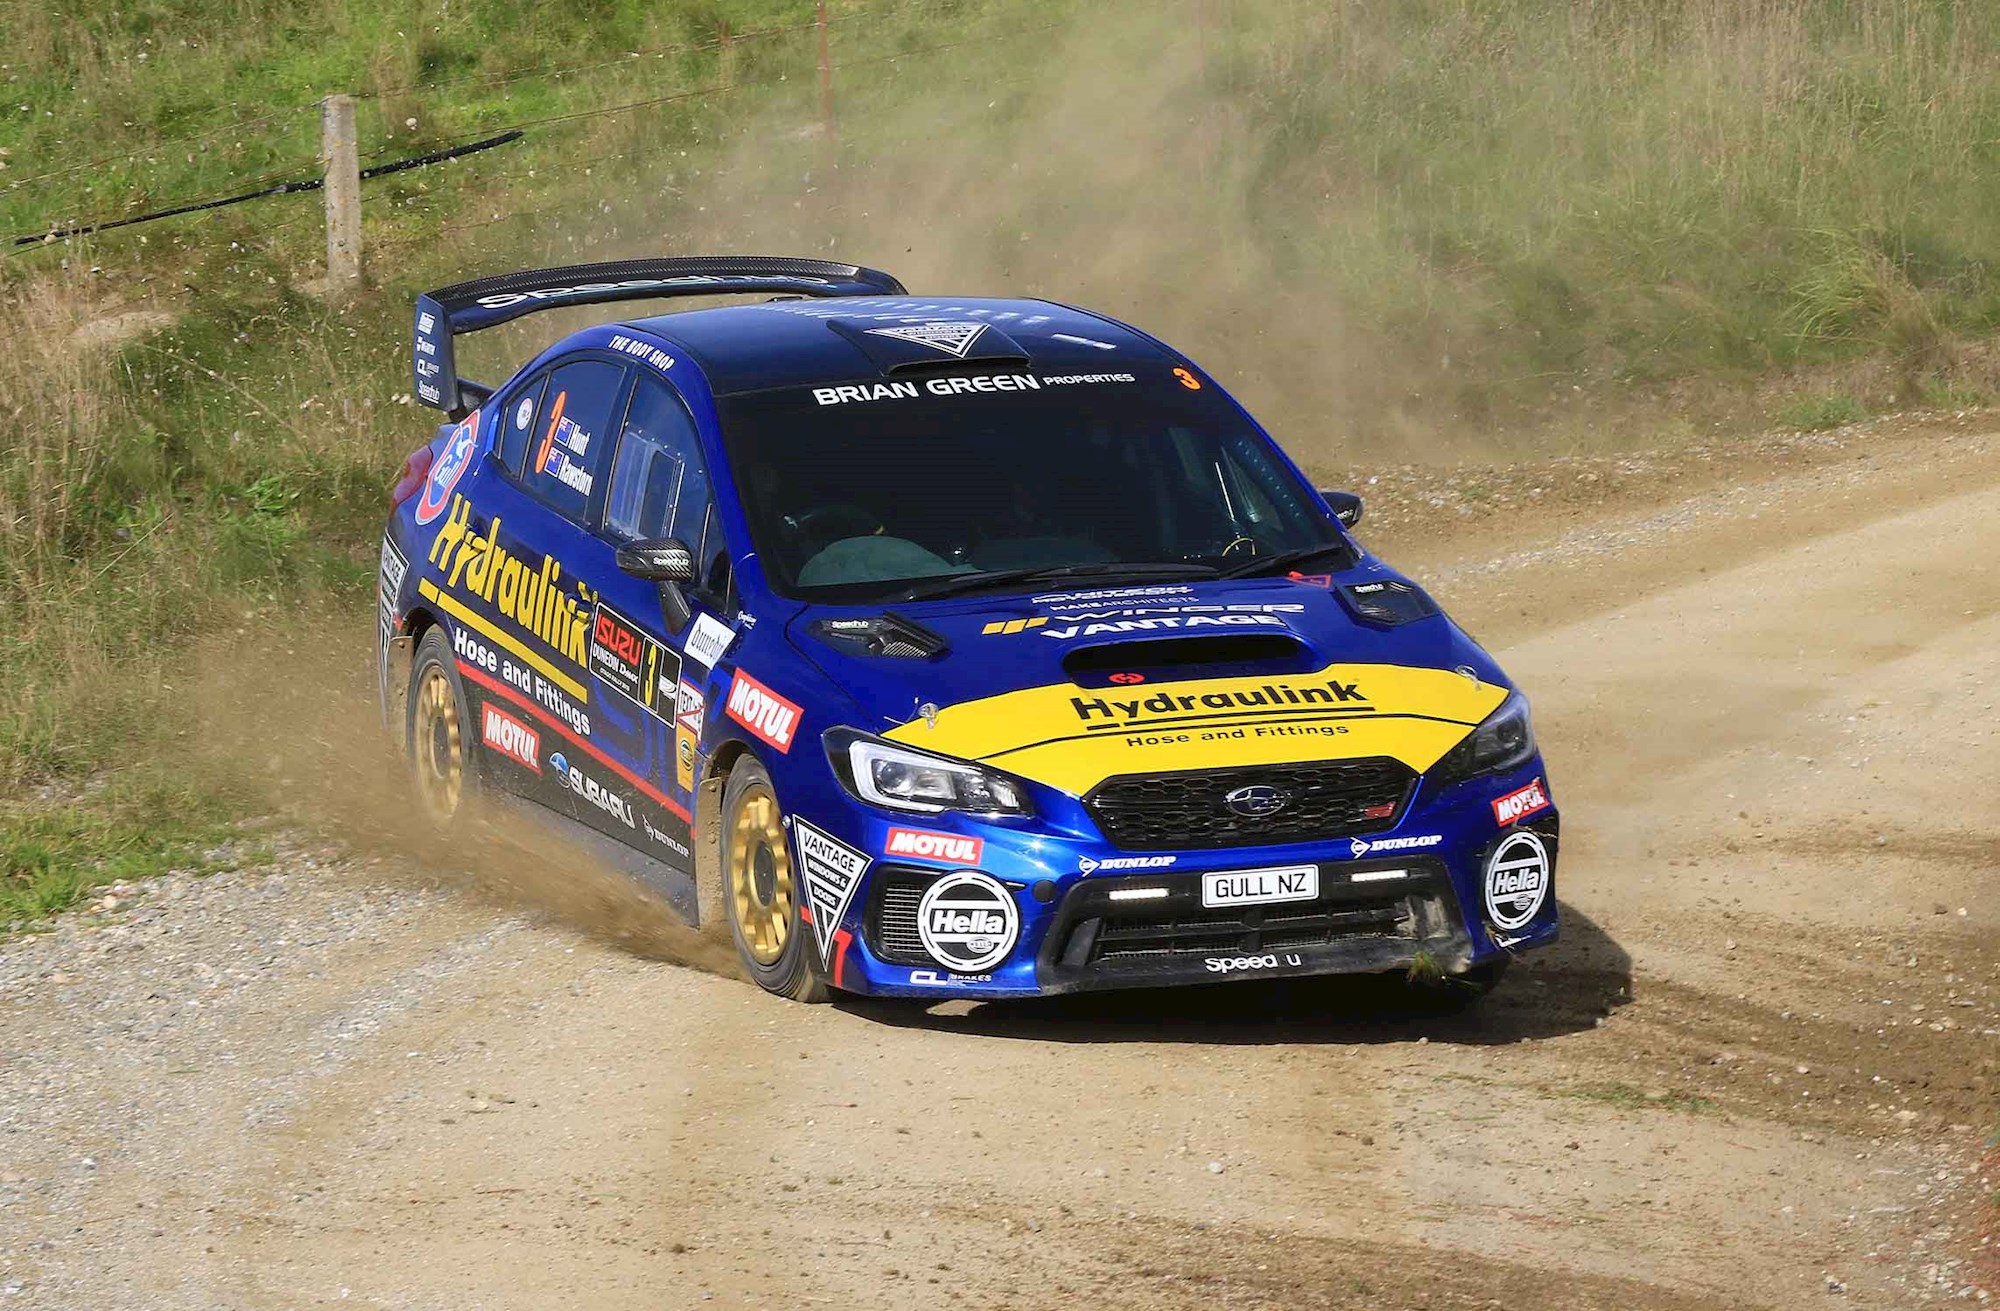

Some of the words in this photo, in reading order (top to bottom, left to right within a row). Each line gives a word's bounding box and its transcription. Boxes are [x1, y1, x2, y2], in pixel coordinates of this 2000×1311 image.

[608, 335, 631, 351] THE
[626, 340, 655, 358] BODY
[649, 349, 675, 371] SHOP
[812, 381, 919, 406] BRIAN
[926, 373, 1041, 397] GREEN
[1043, 373, 1136, 387] PROPERTIES
[1172, 368, 1201, 391] 3
[535, 391, 566, 474] 3
[568, 423, 591, 457] Hunt
[429, 492, 588, 669] Hydraulink
[595, 613, 641, 667] ISUZU
[1040, 615, 1288, 639] VANTAGE
[593, 643, 620, 672] DUNEDIN
[454, 627, 498, 673] Hose
[502, 660, 531, 694] and
[535, 676, 591, 735] Fittings
[644, 644, 657, 706] 3
[729, 678, 795, 745] MOTUL
[1070, 679, 1368, 719] Hydraulink
[485, 710, 537, 768] MOTUL
[1126, 732, 1190, 748] Hose
[1201, 728, 1245, 742] and
[1255, 722, 1350, 740] Fittings
[569, 766, 636, 829] SUBARU
[1498, 785, 1545, 822] MOTUL
[804, 832, 856, 873] VANTAGE
[890, 832, 977, 861] MOTUL
[1371, 835, 1443, 851] DUNLOP
[1098, 856, 1177, 870] DUNLOP
[813, 885, 836, 906] DOORS
[1215, 876, 1272, 899] GULL
[1277, 872, 1306, 893] NZ
[1493, 871, 1539, 895] Hella
[931, 910, 1004, 934] Hella
[910, 970, 948, 985] CL
